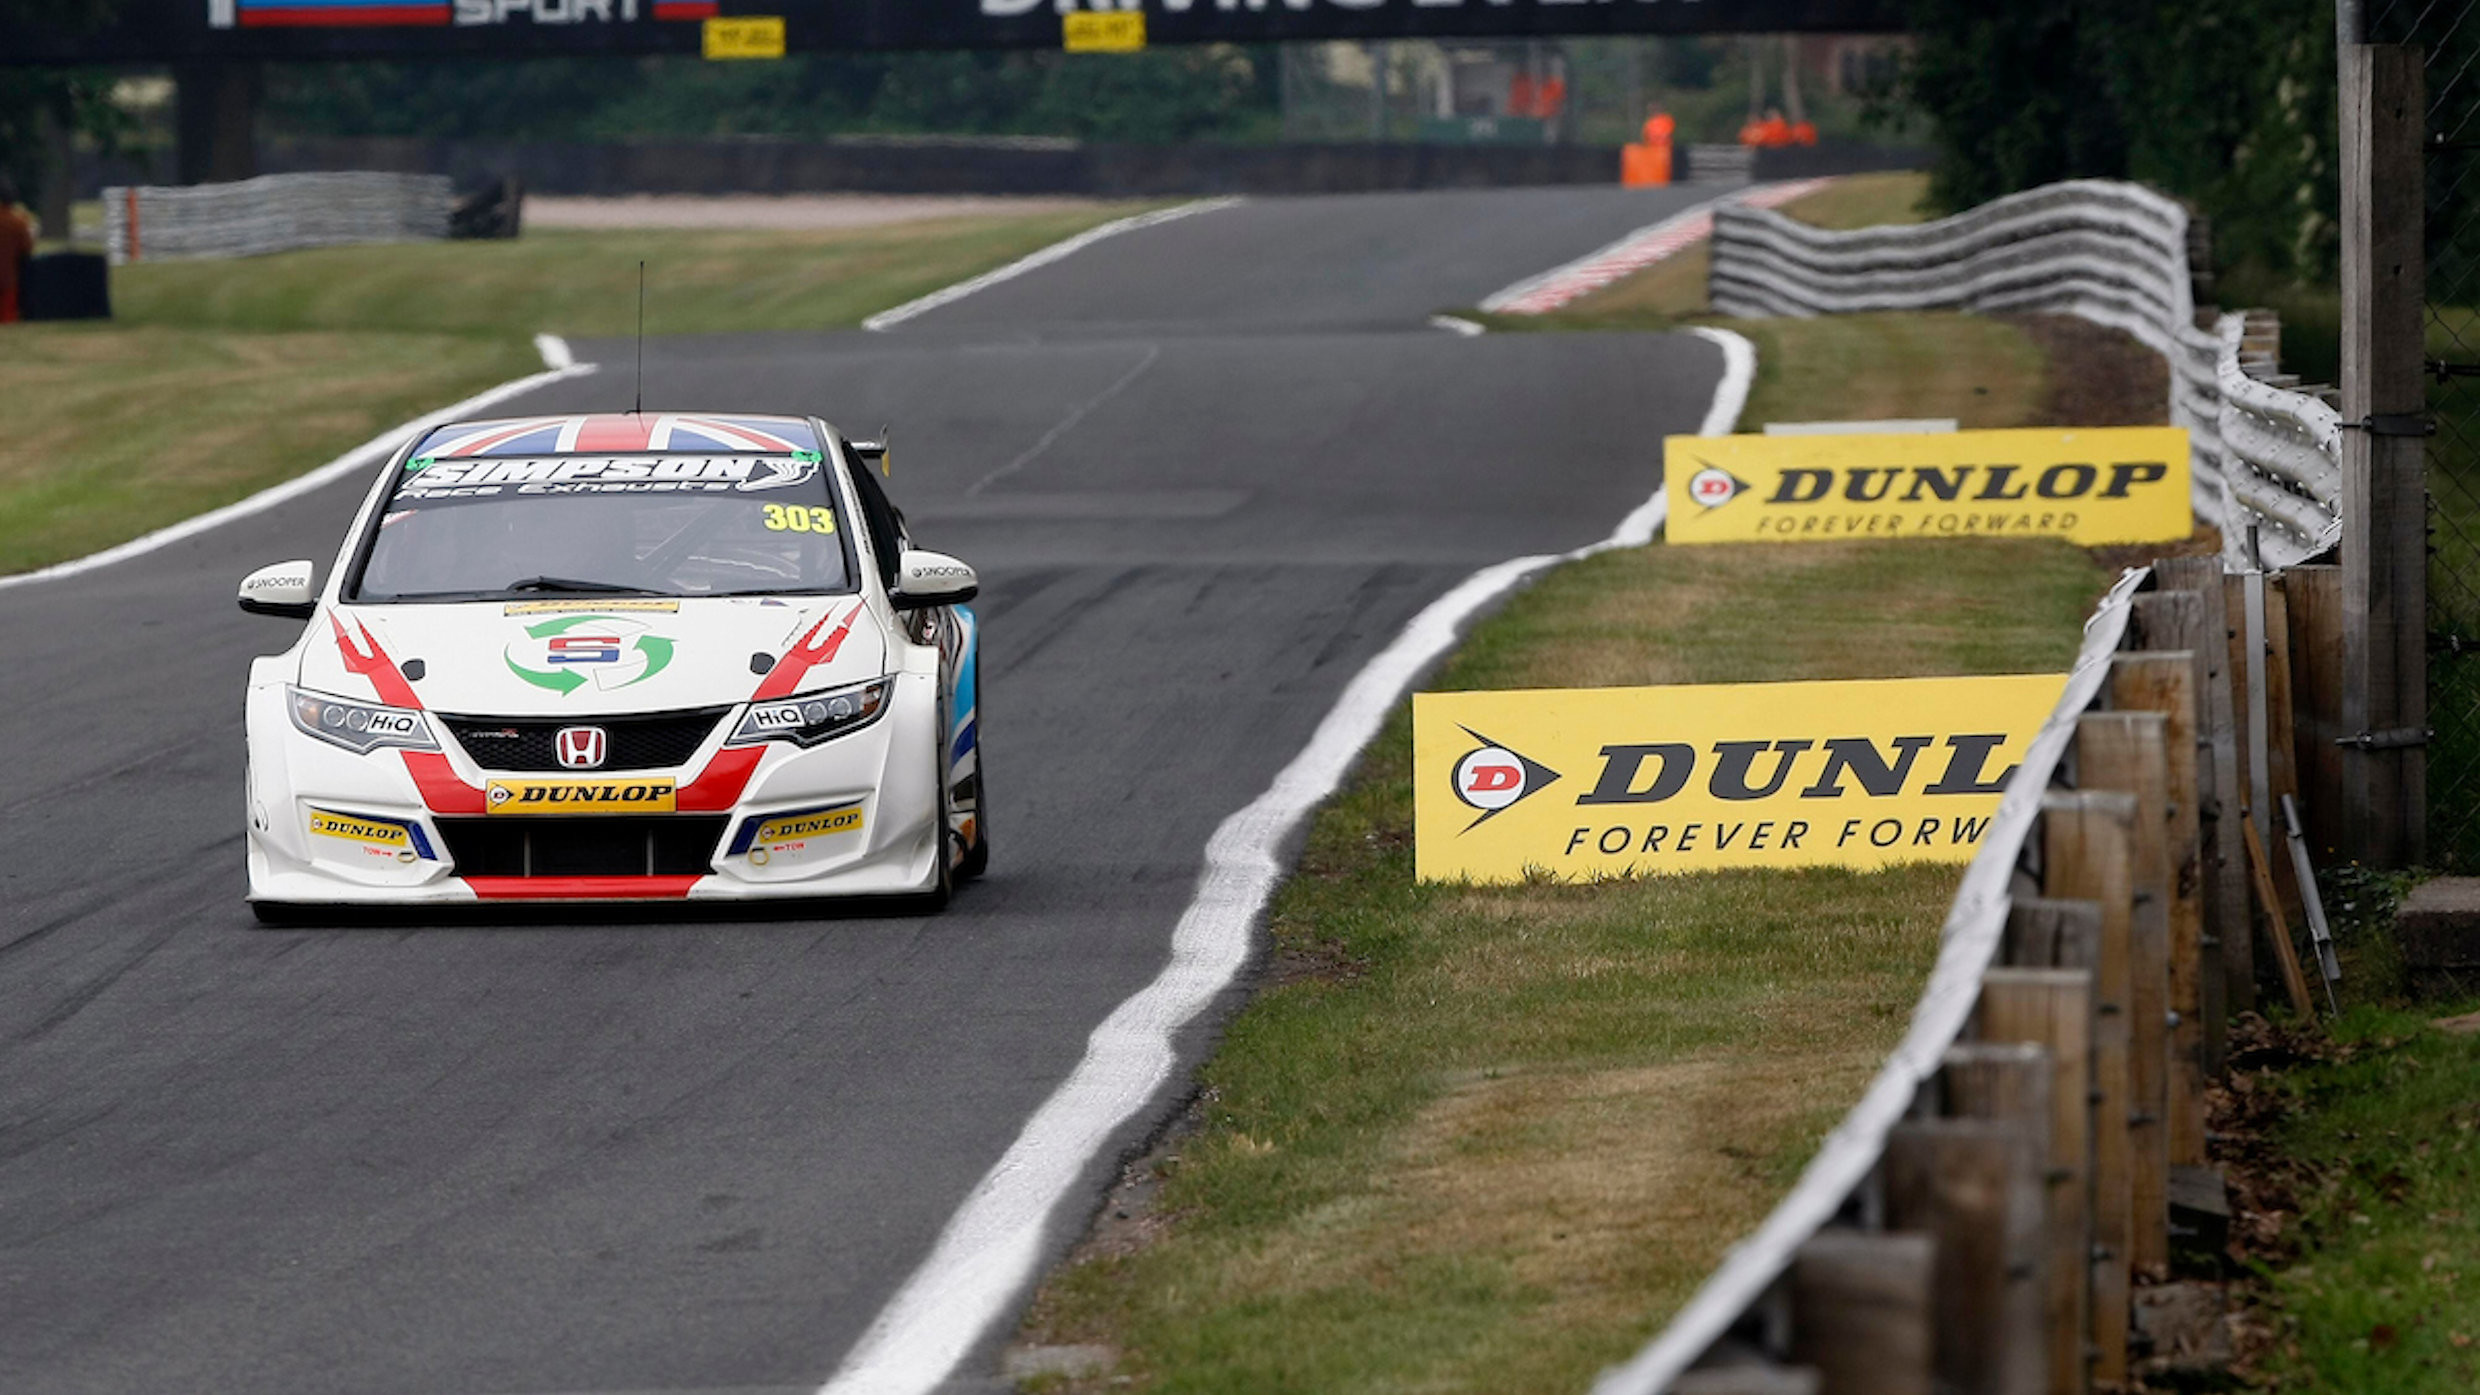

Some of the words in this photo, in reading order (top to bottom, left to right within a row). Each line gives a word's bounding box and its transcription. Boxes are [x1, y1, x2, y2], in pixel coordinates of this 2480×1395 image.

[404, 456, 757, 487] SIMPSON
[1765, 462, 2167, 504] DUNLOP
[763, 503, 835, 535] 303
[1756, 514, 1902, 536] FOREVER
[1920, 511, 2079, 532] FORWARD
[371, 714, 414, 732] HiQ
[754, 708, 800, 726] HiQ
[1575, 734, 2021, 805] DUNL
[518, 785, 672, 803] DUNLOP
[325, 820, 404, 841] DUNLOP
[778, 813, 859, 837] DUNLOP
[1564, 820, 1810, 855] FOREVER
[1838, 816, 1992, 848] FORW
